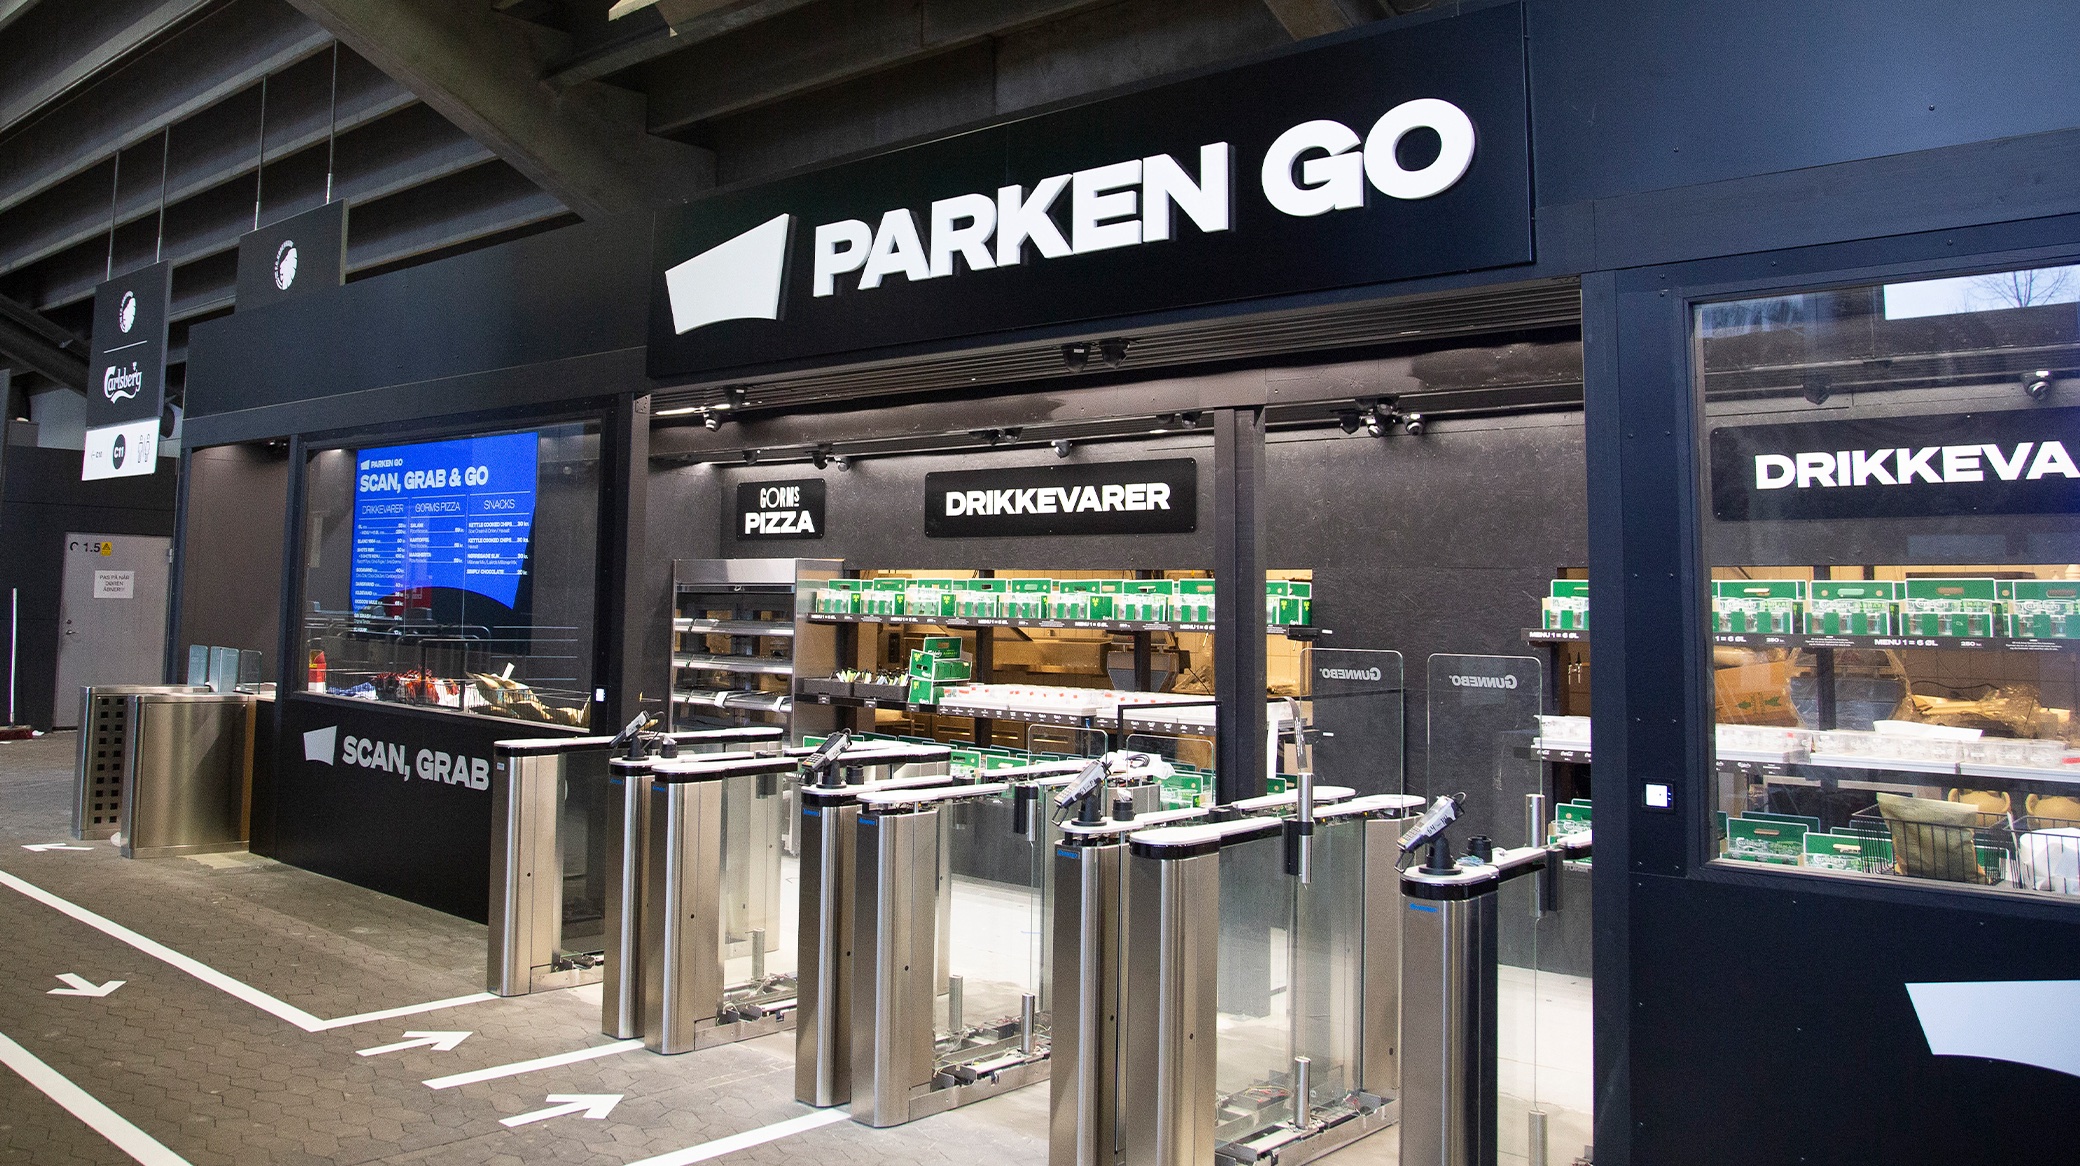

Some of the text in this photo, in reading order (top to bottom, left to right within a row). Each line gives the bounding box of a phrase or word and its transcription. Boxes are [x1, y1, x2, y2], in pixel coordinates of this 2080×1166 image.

[813, 98, 1476, 298] PARKEN GO
[104, 362, 142, 404] Carlsberg
[114, 446, 124, 458] C11
[371, 460, 393, 468] PARKEN
[1755, 441, 2080, 490] DRIKKEVA
[360, 466, 488, 493] SCAN, GRAB & GO
[415, 502, 460, 512] GORMS PIZZA
[484, 499, 515, 510] SNACKS
[760, 486, 800, 508] GORMS
[945, 482, 1171, 517] DRIKKEVARER
[745, 510, 815, 534] PIZZA
[84, 543, 100, 552] 1.5
[342, 735, 490, 791] SCAN, GRAB
